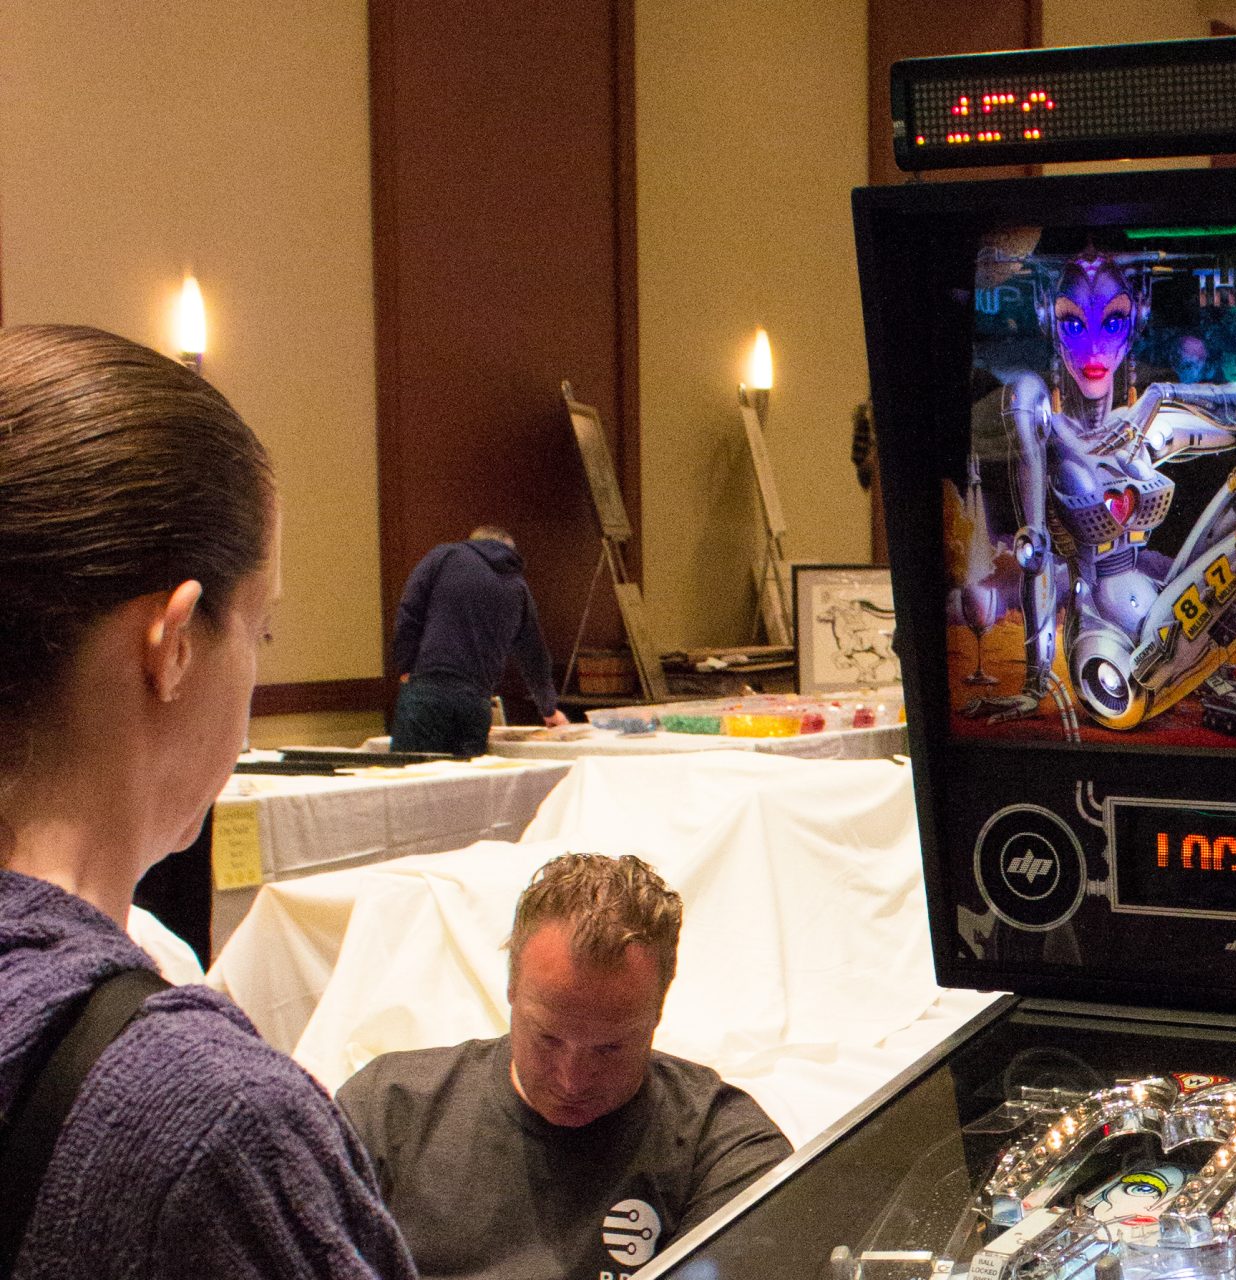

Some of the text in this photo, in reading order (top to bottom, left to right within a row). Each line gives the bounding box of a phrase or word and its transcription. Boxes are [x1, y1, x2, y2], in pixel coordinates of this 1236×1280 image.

[1211, 565, 1226, 585] 7
[1180, 598, 1199, 619] 8
[978, 1259, 994, 1267] BALL
[971, 1266, 998, 1276] LOCKED
